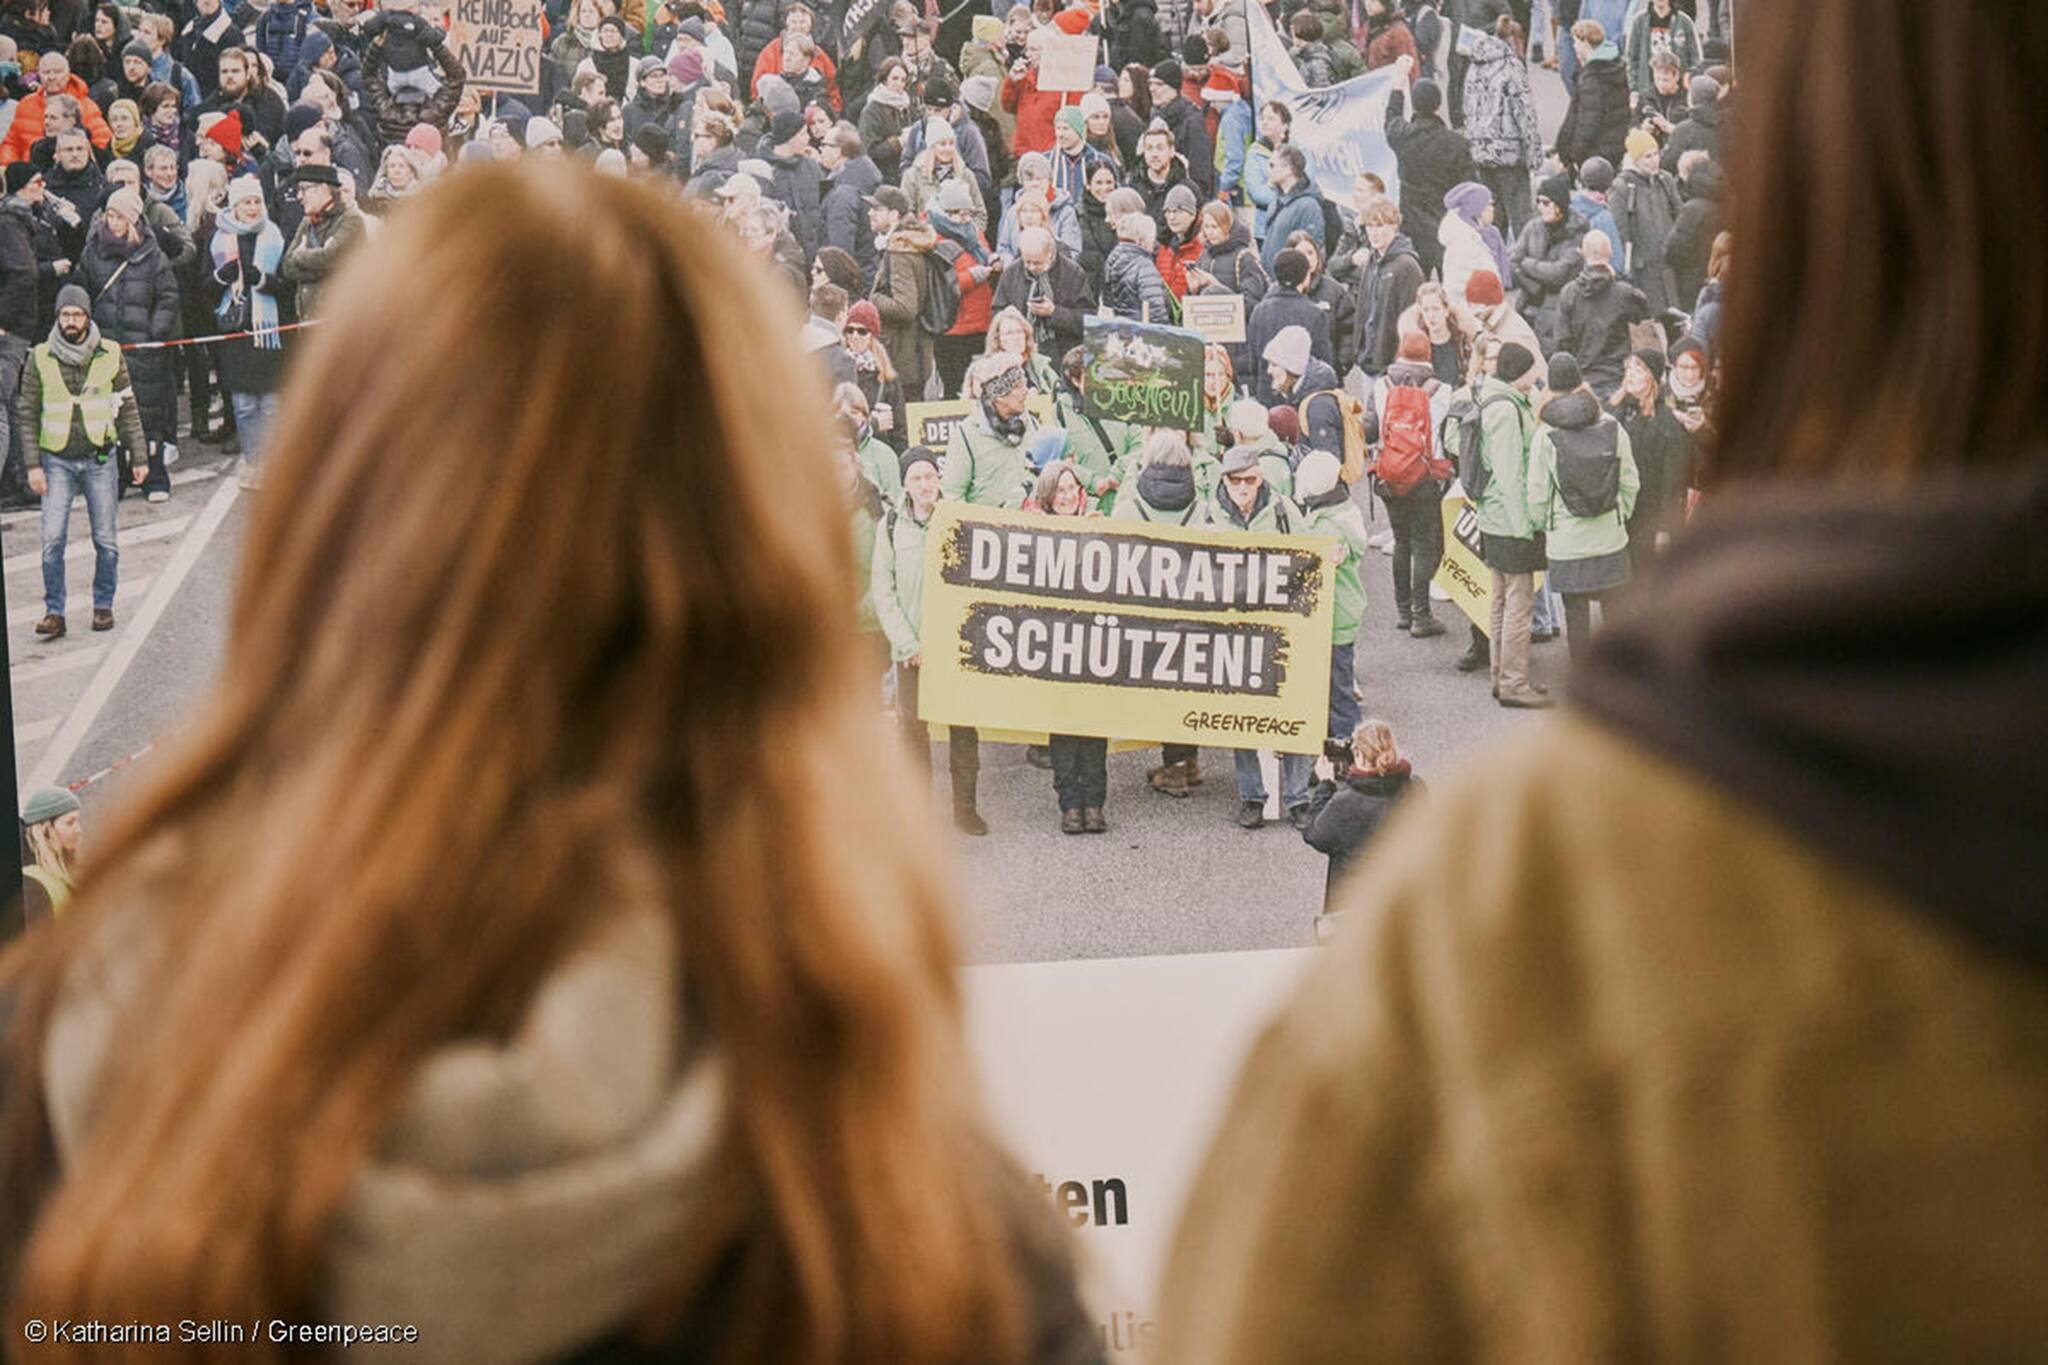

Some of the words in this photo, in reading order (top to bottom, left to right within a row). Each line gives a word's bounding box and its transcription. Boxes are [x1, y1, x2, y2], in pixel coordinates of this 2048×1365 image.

[476, 29, 510, 45] AUF
[970, 528, 1291, 606] DEMOKRATIE
[984, 613, 1265, 689] SCHÜTZEN!
[1183, 711, 1306, 736] GREENPEACE
